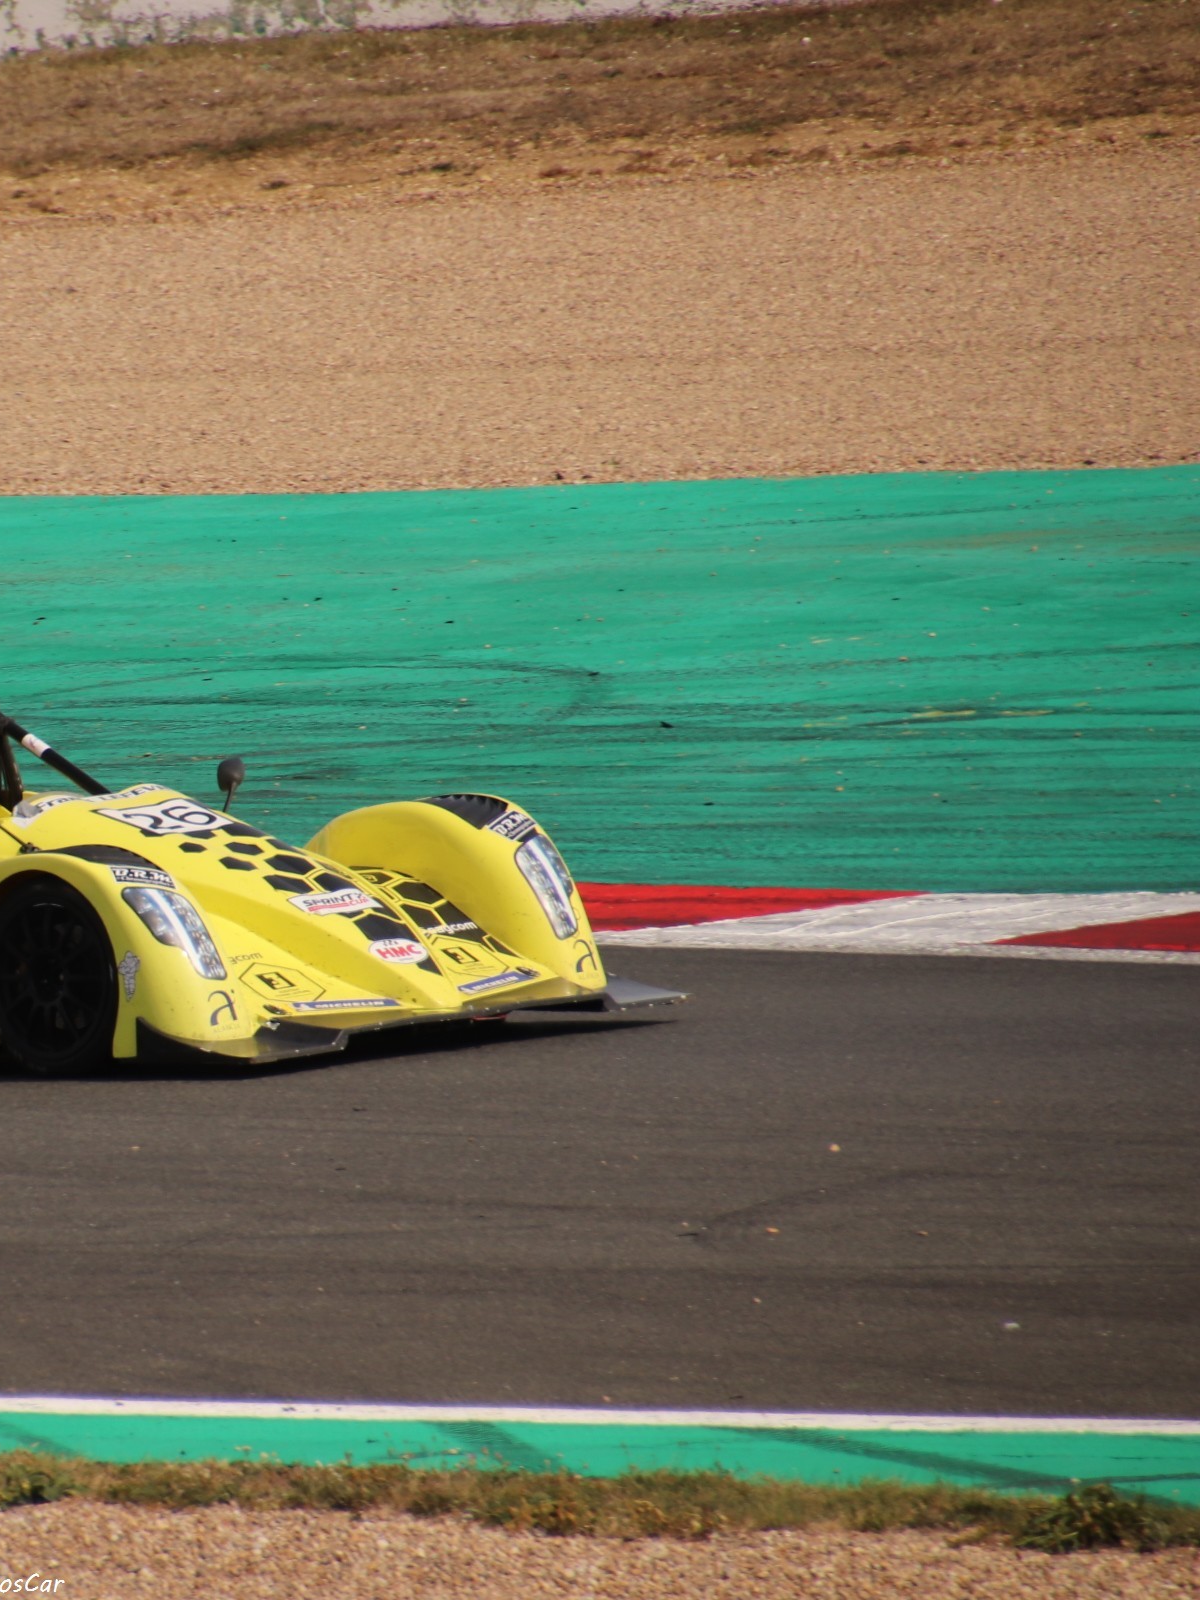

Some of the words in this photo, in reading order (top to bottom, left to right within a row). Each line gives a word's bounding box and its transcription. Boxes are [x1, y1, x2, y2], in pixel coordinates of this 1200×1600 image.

[122, 804, 218, 830] 26
[302, 893, 353, 907] SPRINT
[375, 944, 422, 959] HMC
[314, 1000, 385, 1009] MICHELIN
